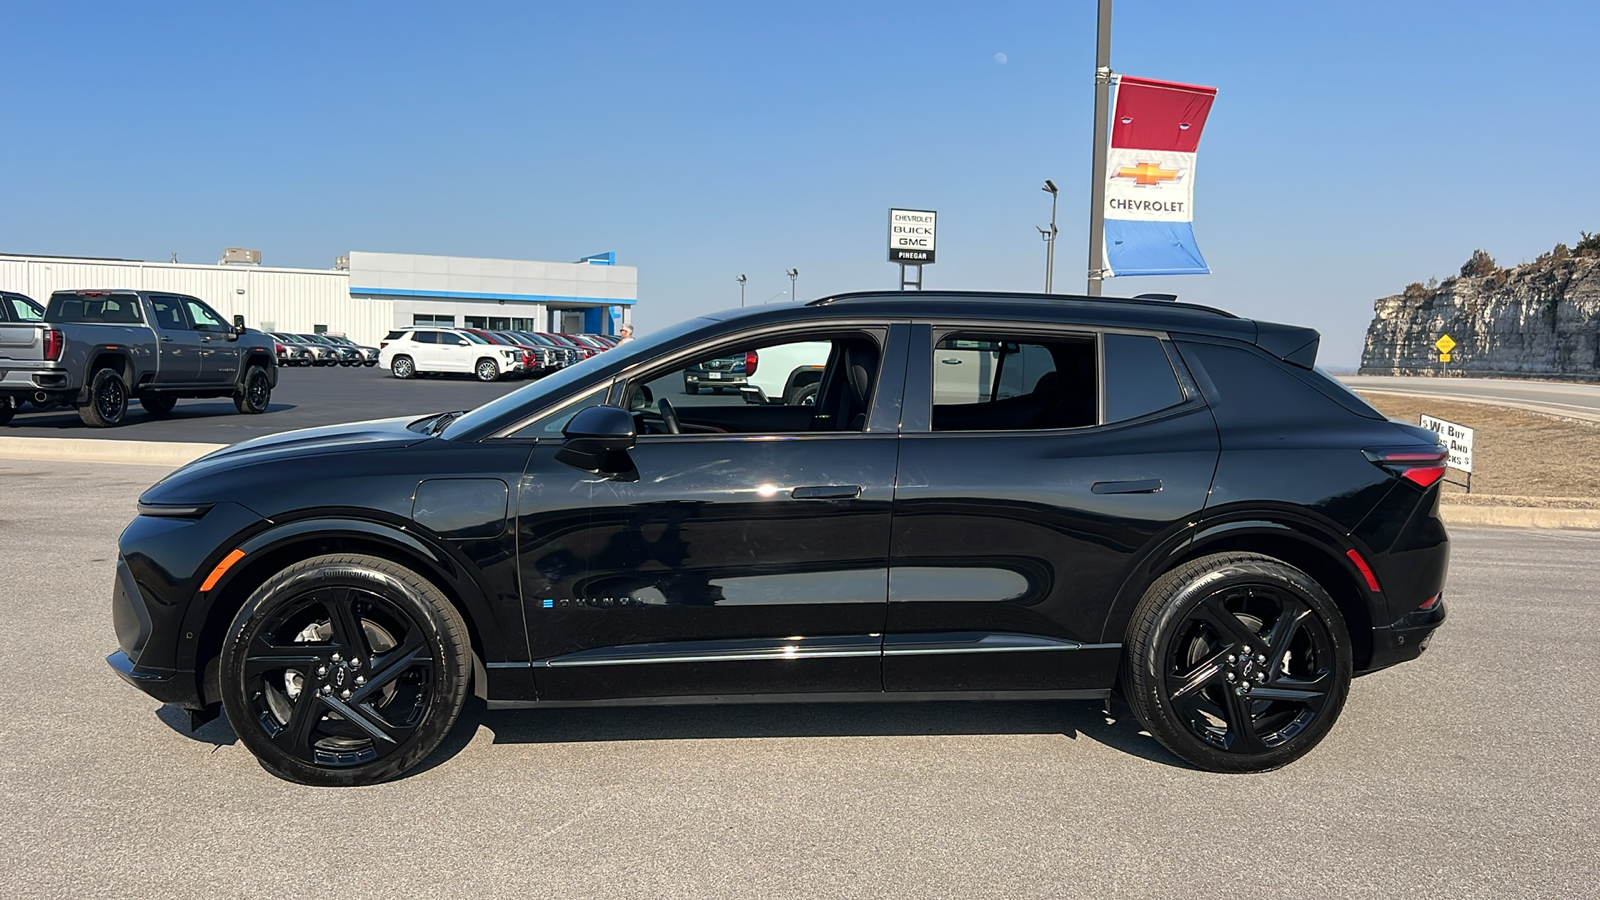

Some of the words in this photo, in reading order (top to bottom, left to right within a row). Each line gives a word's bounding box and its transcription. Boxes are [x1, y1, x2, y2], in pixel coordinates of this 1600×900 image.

[895, 214, 932, 223] CHEVROLET
[893, 226, 932, 235] BUICK
[899, 238, 927, 246] GMC
